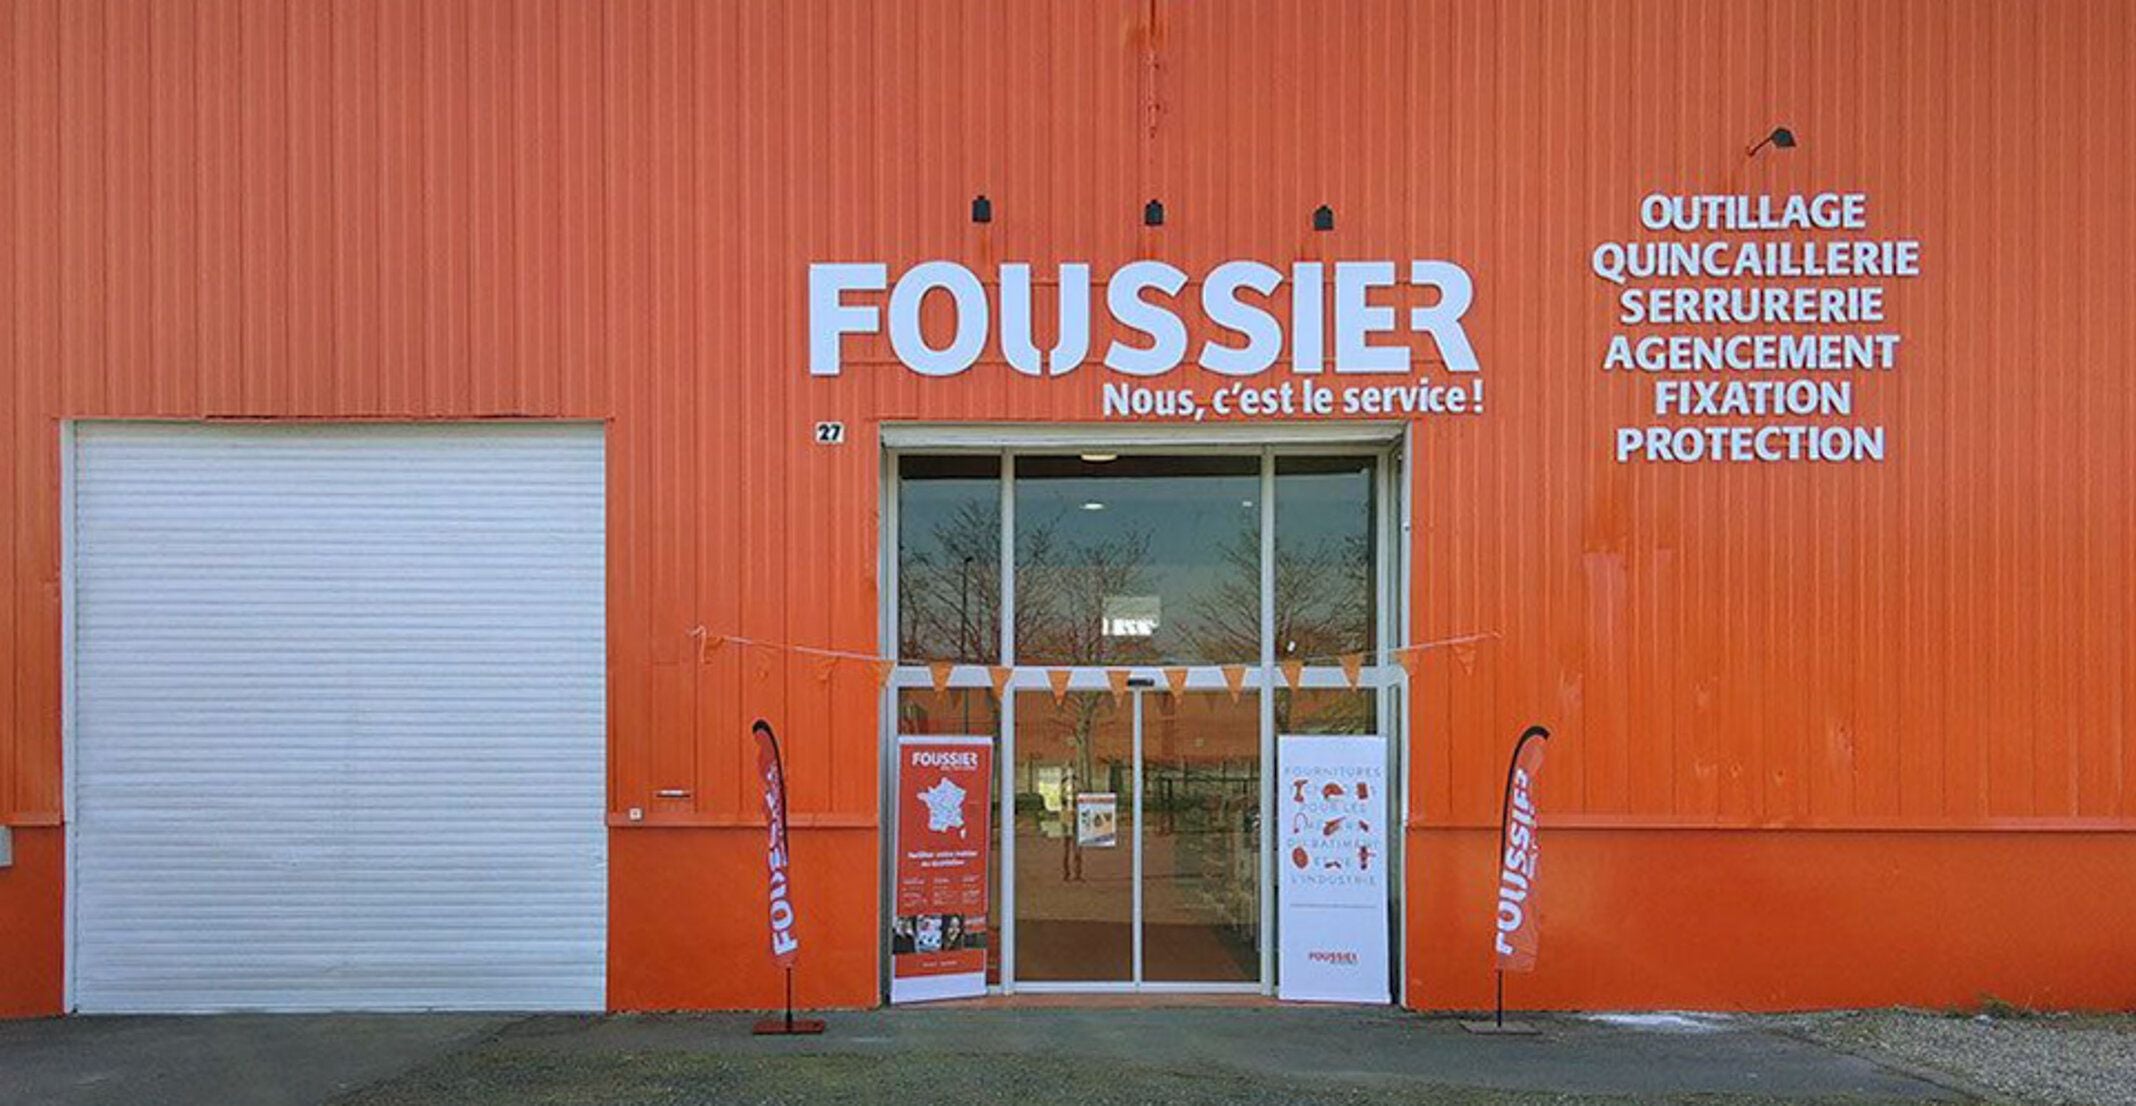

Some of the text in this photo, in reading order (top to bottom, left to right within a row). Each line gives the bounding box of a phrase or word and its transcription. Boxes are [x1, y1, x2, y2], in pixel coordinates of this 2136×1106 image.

[1640, 193, 1867, 231] OUTILLAGE
[1592, 241, 1920, 284] QUINCAILLERIE
[808, 260, 1480, 376] FOUSSIER
[1620, 287, 1884, 324] SERRURERIE
[1604, 334, 1901, 370] AGENCEMENT
[1102, 382, 1205, 421] Nous,
[1302, 379, 1333, 414] le
[1655, 379, 1851, 415] FIXATION
[818, 423, 841, 441] 27
[1617, 426, 1885, 462] PROTECTION
[912, 751, 978, 767] FOUSSIER
